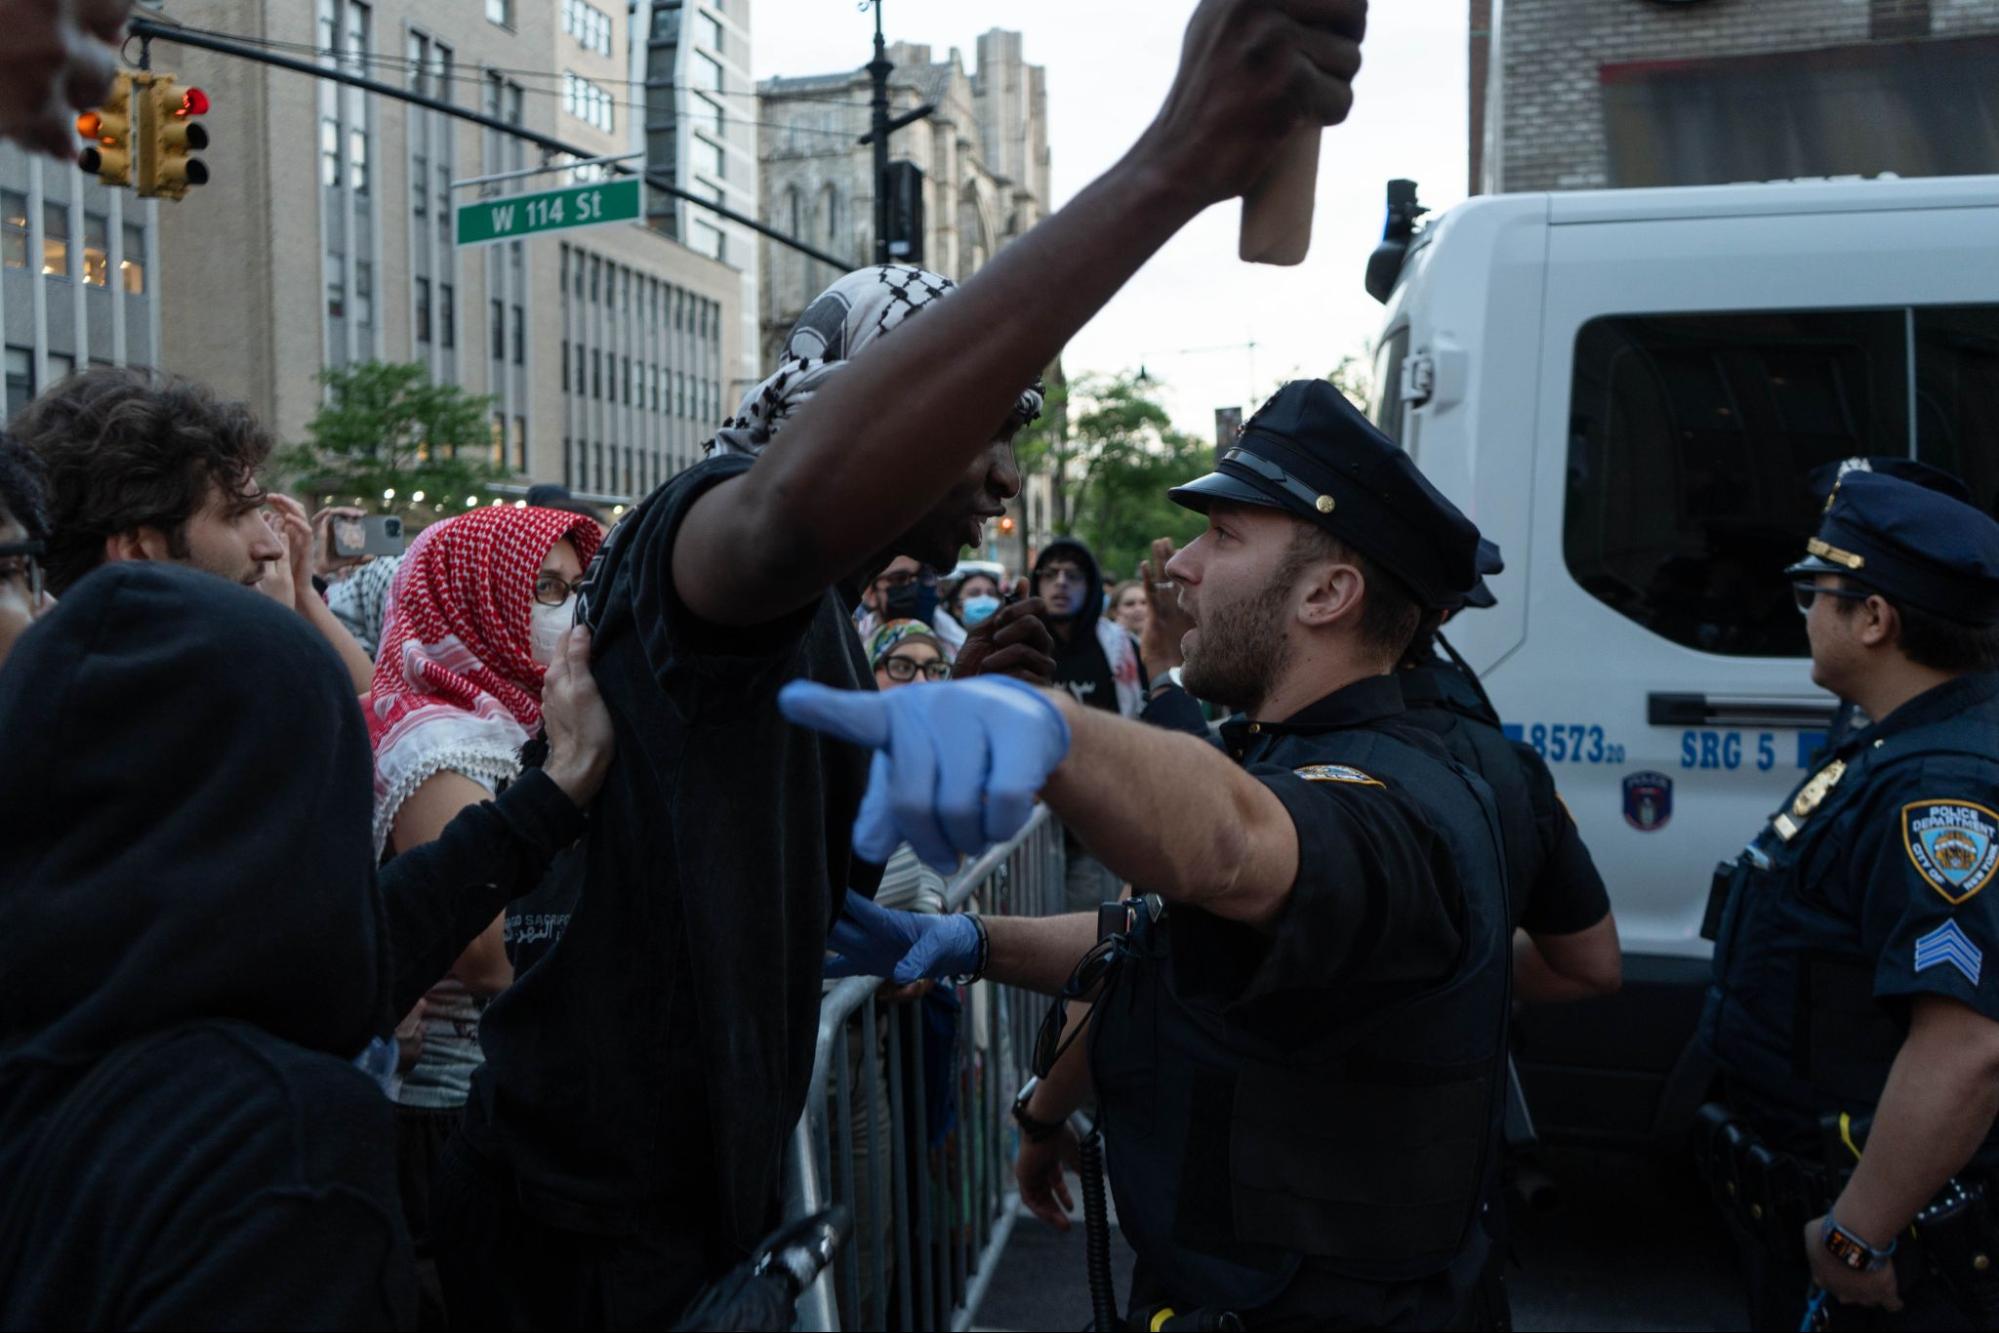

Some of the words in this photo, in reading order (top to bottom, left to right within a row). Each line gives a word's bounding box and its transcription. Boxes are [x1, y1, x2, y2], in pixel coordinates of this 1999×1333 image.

[491, 205, 515, 233] W
[525, 197, 565, 228] 114
[576, 191, 602, 221] St
[1531, 724, 1604, 763] 8573
[1681, 730, 1742, 770] SRG
[1757, 731, 1775, 771] 5
[1912, 817, 1996, 838] DEPARTMENT
[1929, 806, 1979, 821] POLICE
[1912, 843, 1932, 868] CITY
[1928, 868, 1946, 885] OF
[1962, 870, 1985, 892] NEW
[1982, 844, 1999, 871] YORK
